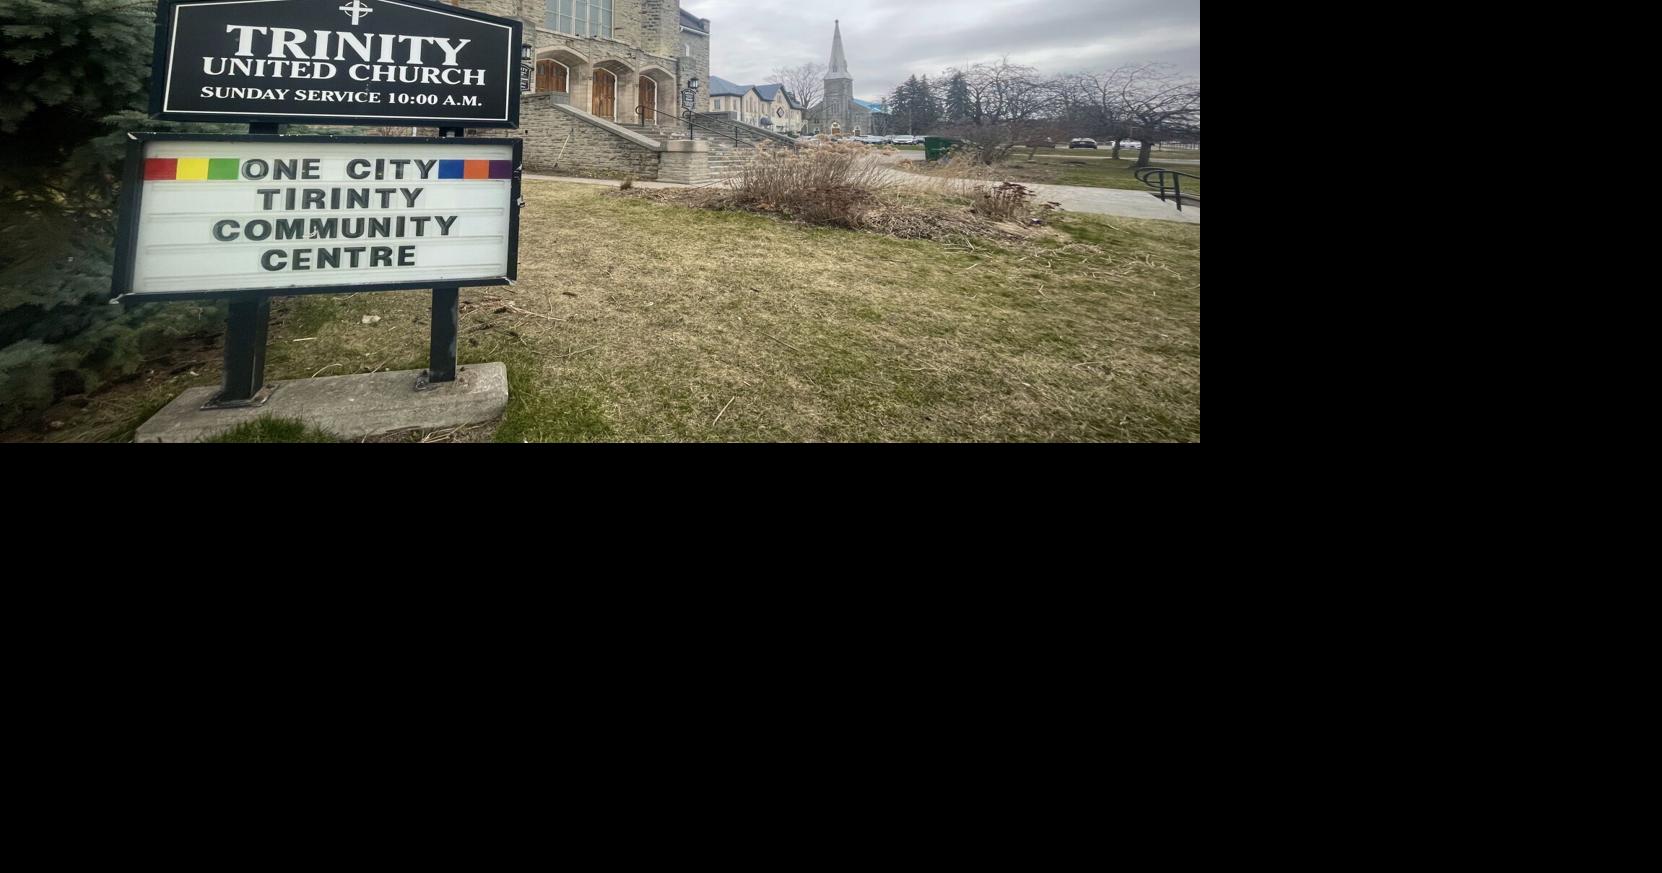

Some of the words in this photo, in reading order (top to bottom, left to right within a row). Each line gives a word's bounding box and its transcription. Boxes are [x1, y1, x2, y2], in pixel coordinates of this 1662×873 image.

[226, 24, 471, 66] TRINITY
[202, 57, 336, 80] UNITED
[349, 64, 486, 86] CHURCH
[200, 86, 290, 101] SUNDAY
[295, 89, 381, 104] SERVICE
[388, 93, 438, 106] 10:00
[442, 95, 482, 107] A.M.
[241, 158, 320, 180] ONE
[346, 158, 437, 180] CITY
[257, 187, 423, 211] TIRINTY
[213, 215, 458, 242] COMMUNITY
[261, 245, 416, 271] CENTRE
